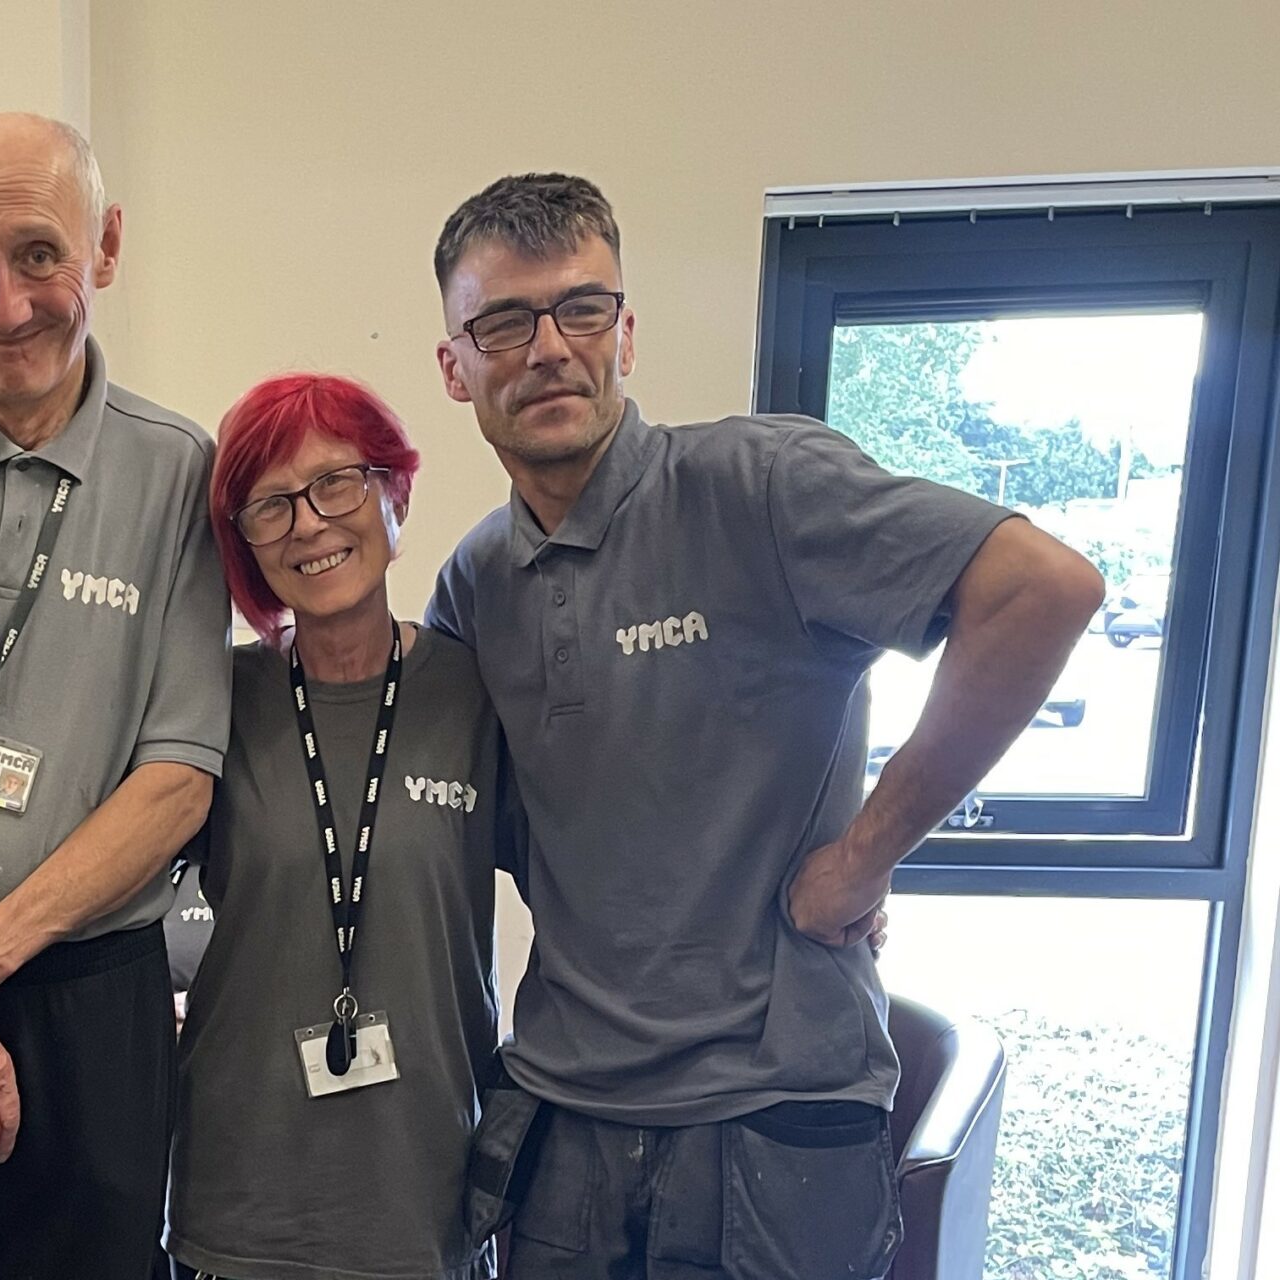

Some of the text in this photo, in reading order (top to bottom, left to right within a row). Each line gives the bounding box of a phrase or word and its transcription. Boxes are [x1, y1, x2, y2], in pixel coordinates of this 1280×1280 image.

[51, 478, 71, 513] YMCA
[27, 553, 49, 589] YMCA
[60, 568, 140, 615] YMCA
[616, 610, 709, 655] YMCA
[384, 681, 396, 707] YMCA
[375, 728, 388, 755] YMCA
[367, 777, 379, 803] YMCA
[404, 775, 477, 813] YMCA
